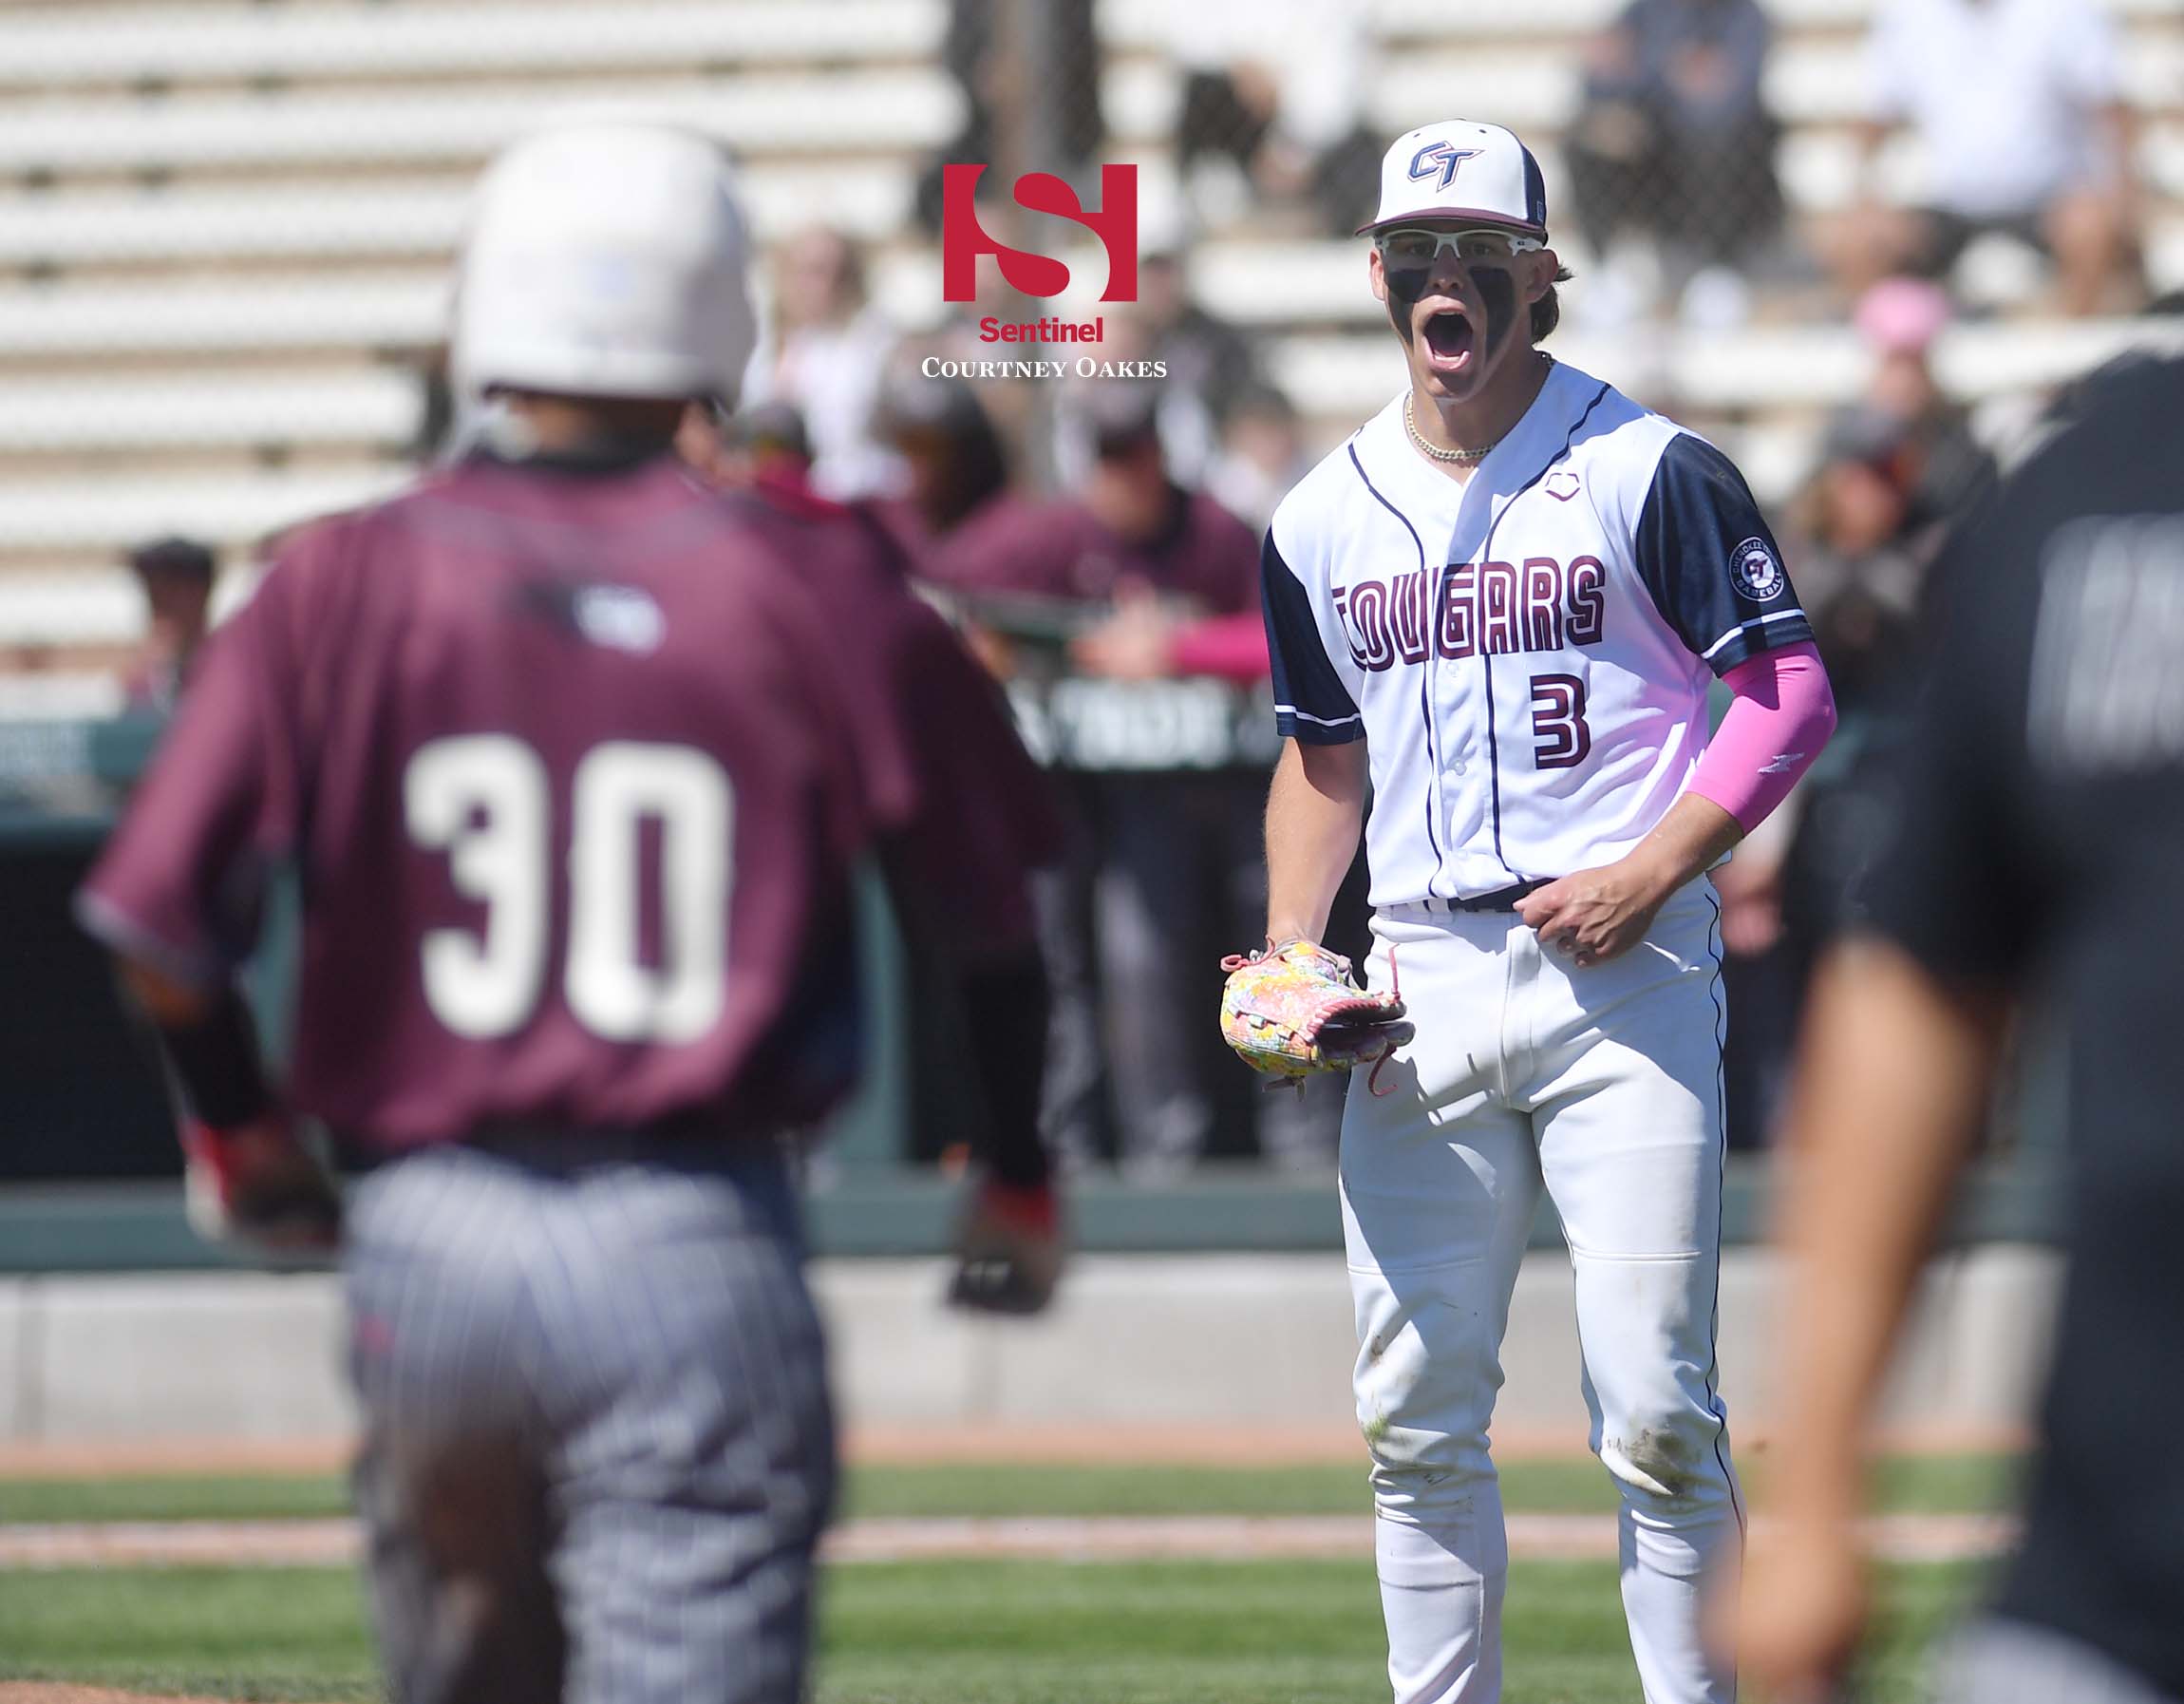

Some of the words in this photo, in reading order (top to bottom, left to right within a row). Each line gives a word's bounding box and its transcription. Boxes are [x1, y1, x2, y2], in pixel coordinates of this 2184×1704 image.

[1407, 140, 1486, 193] CT
[1530, 673, 1591, 770] 3
[404, 732, 737, 1044] 30
